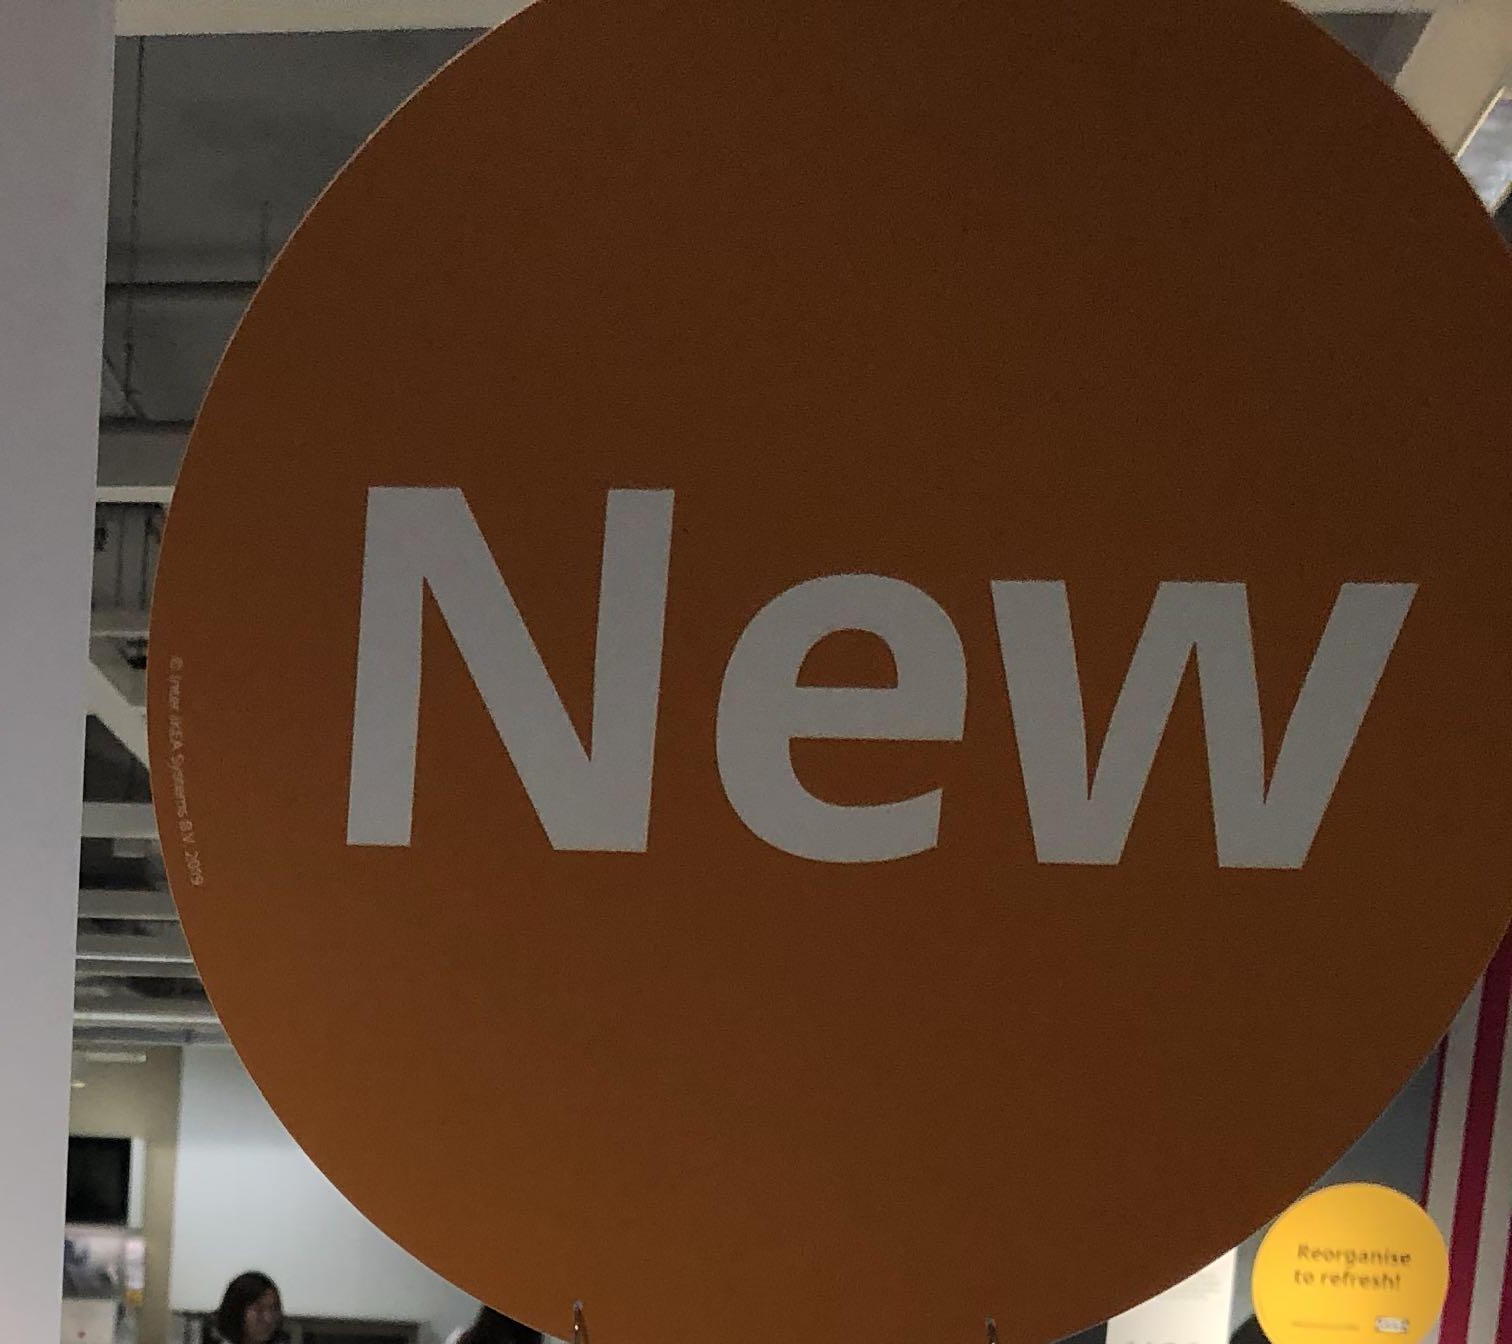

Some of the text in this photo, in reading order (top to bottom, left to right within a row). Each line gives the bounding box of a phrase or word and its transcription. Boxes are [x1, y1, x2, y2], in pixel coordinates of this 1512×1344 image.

[346, 486, 1418, 870] New
[1297, 1242, 1411, 1268] Reorganise
[1294, 1268, 1401, 1292] to refresh!
